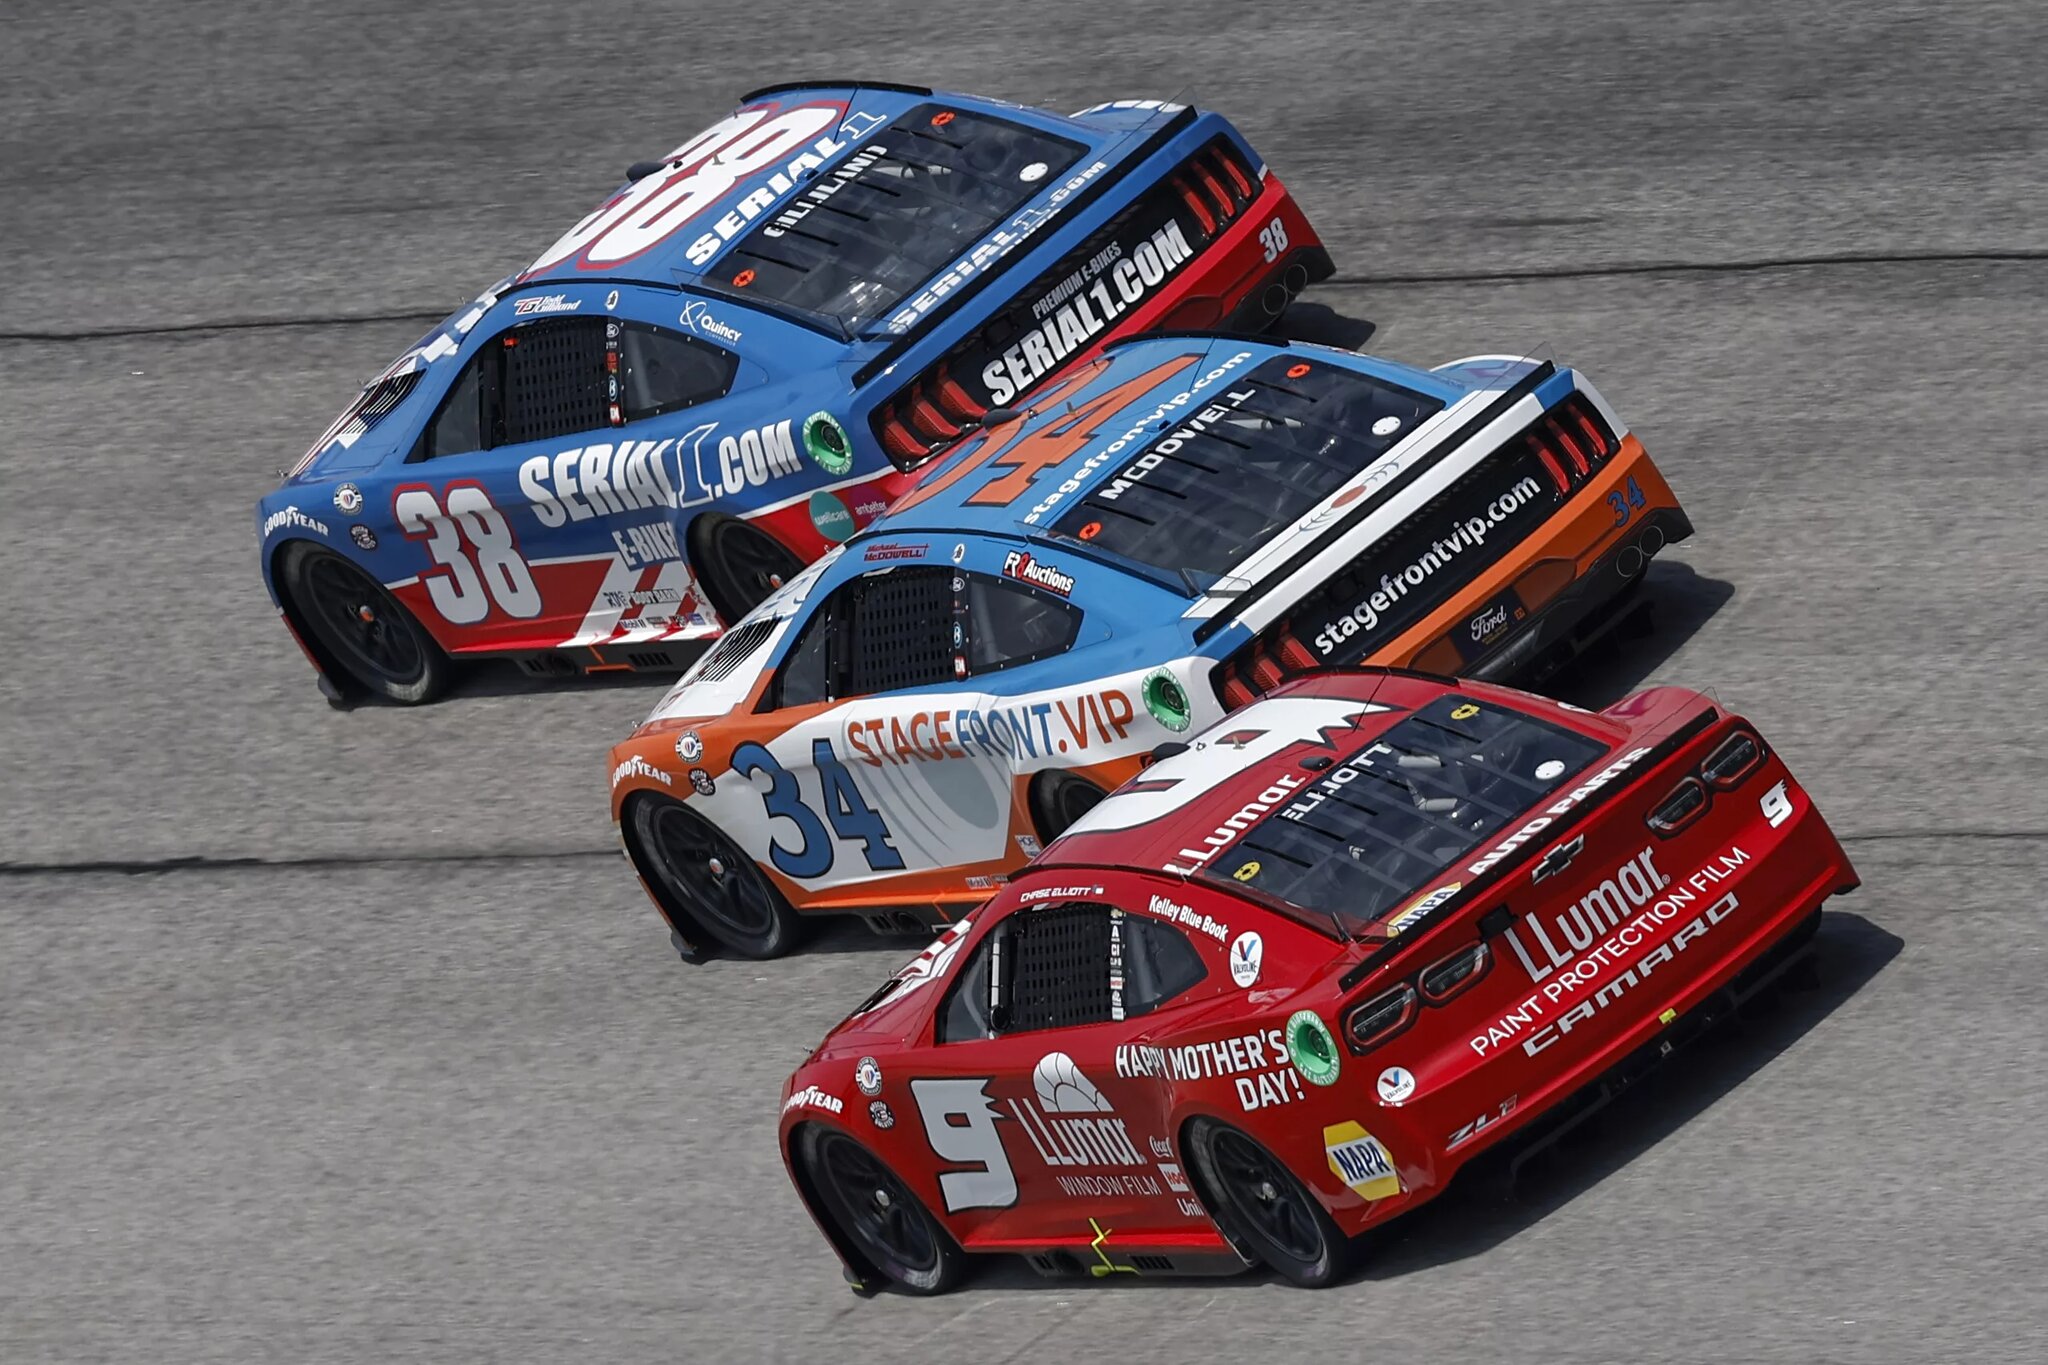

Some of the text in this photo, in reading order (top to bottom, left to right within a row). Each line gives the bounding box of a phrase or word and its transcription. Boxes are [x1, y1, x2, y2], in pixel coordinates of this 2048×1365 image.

[1258, 217, 1290, 265] 38
[1032, 241, 1122, 320] PREMIUM E-BIKES
[701, 314, 743, 342] Quincy
[982, 219, 1194, 407] SERIAL1.COM
[1024, 351, 1252, 525] stagefrontvip.com
[264, 505, 329, 537] GOODYEAR
[1606, 475, 1646, 528] 34
[394, 484, 543, 626] 38
[1313, 472, 1543, 656] stagefrontvip.com
[1471, 604, 1507, 641] Ford
[846, 691, 1136, 769] STAGEFRONT.VIP
[612, 754, 672, 788] GOODYEAR
[1281, 742, 1393, 821] ELLIOTT
[731, 737, 907, 879] 34
[1468, 746, 1653, 876] AUTO PARTS
[1759, 778, 1795, 829] 9
[1020, 886, 1092, 903] CHASE ELLIOTT
[1148, 894, 1229, 944] Kelley Blue Book
[1396, 889, 1456, 928] NAPA
[1503, 845, 1668, 984] LLumar
[1469, 845, 1752, 1057] PAINT PROTECTION FILM
[1521, 891, 1741, 1058] CAMARO
[1114, 1044, 1172, 1081] HAPPY
[1171, 1028, 1290, 1081] MOTHER'S
[1235, 1066, 1305, 1112] DAY!
[910, 1077, 1018, 1214] 9
[1007, 1096, 1145, 1167] LLumar
[1332, 1136, 1390, 1181] NAPA
[1055, 1174, 1162, 1197] WINDOW FILM
